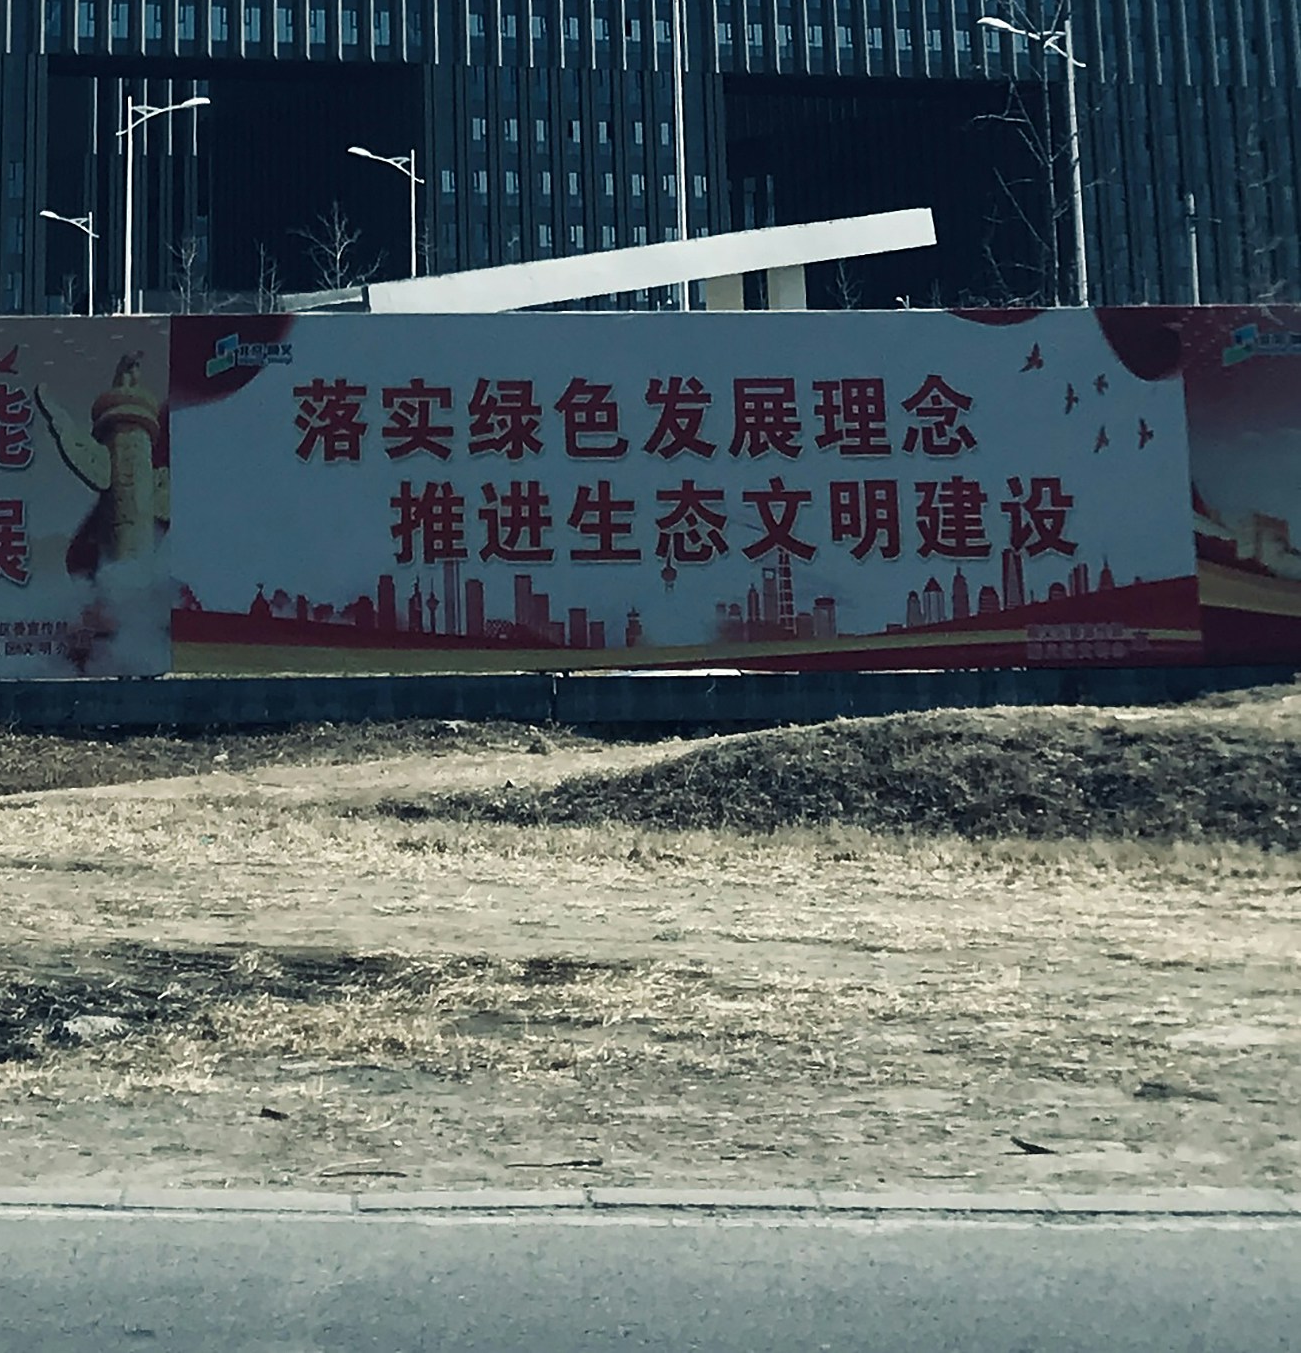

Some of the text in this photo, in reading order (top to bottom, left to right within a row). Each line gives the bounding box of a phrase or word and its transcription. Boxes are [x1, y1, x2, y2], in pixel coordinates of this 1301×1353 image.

[292, 374, 979, 462] 落实绿色发展理念
[389, 476, 1078, 565] 推进生态文明建设
